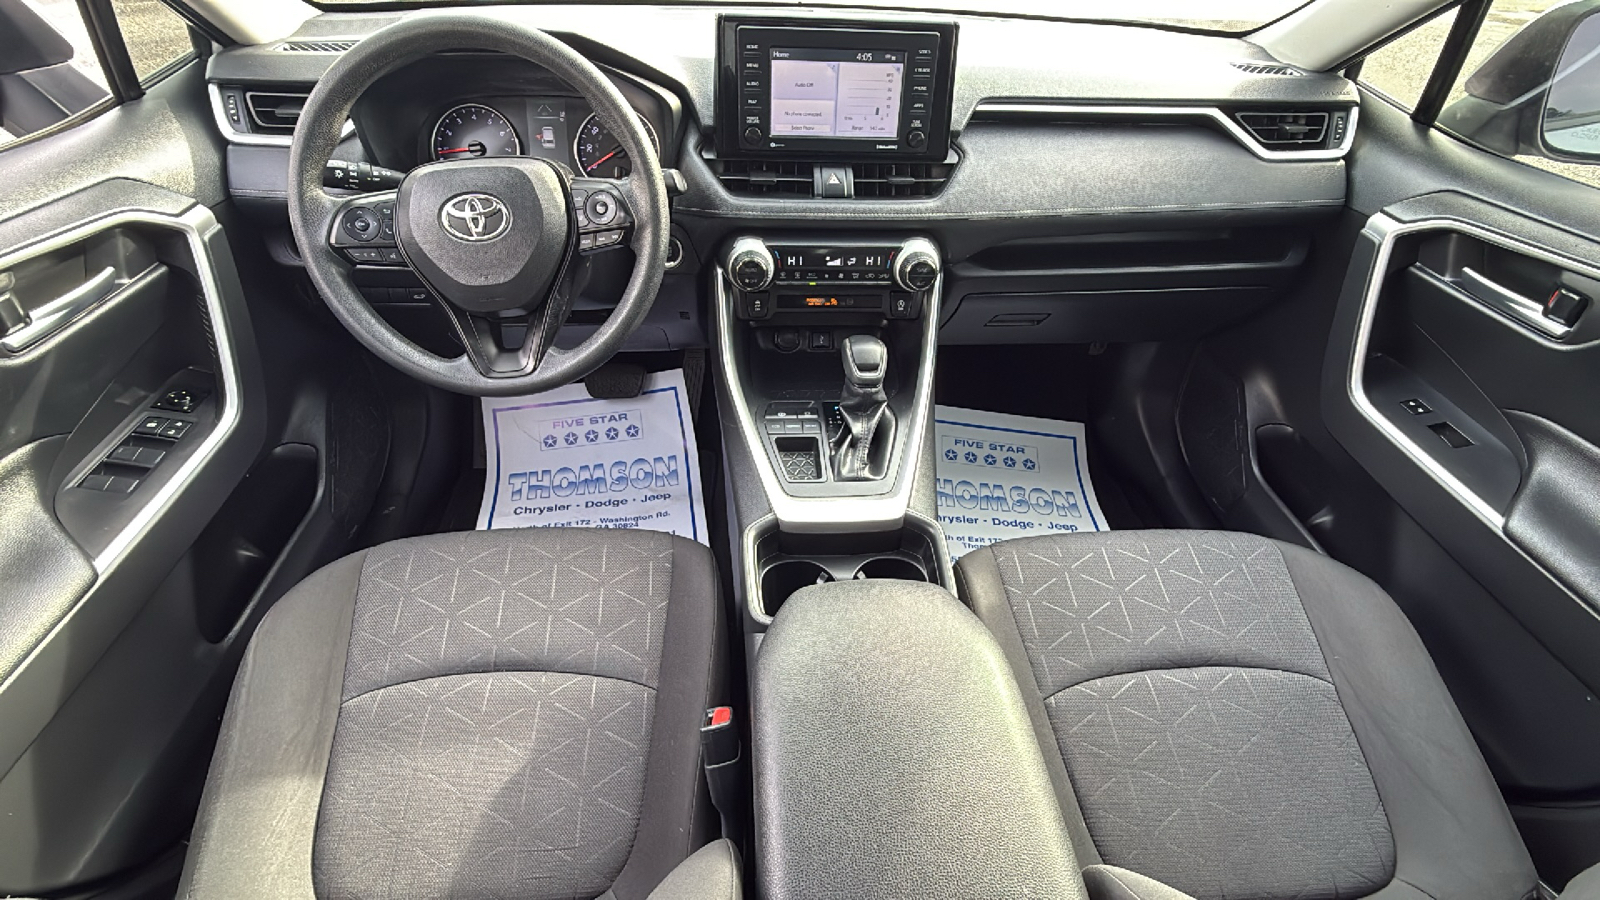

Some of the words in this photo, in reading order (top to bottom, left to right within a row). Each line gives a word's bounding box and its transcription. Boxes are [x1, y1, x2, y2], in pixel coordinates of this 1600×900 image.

[773, 51, 790, 59] Home
[856, 53, 873, 61] 4:05
[552, 418, 585, 430] FIVE
[589, 412, 629, 425] STAR
[954, 438, 985, 450] FIVE
[988, 443, 1026, 455] STAR
[508, 454, 680, 502] THOMSON
[513, 503, 572, 516] Chrysler
[585, 498, 629, 509] Dodge
[641, 492, 672, 504] Jeep
[937, 477, 1083, 518] HOMSON
[600, 513, 653, 524] Washington
[656, 510, 671, 518] Rd.
[992, 517, 1035, 530] Dodge
[1048, 521, 1079, 533] Jeep
